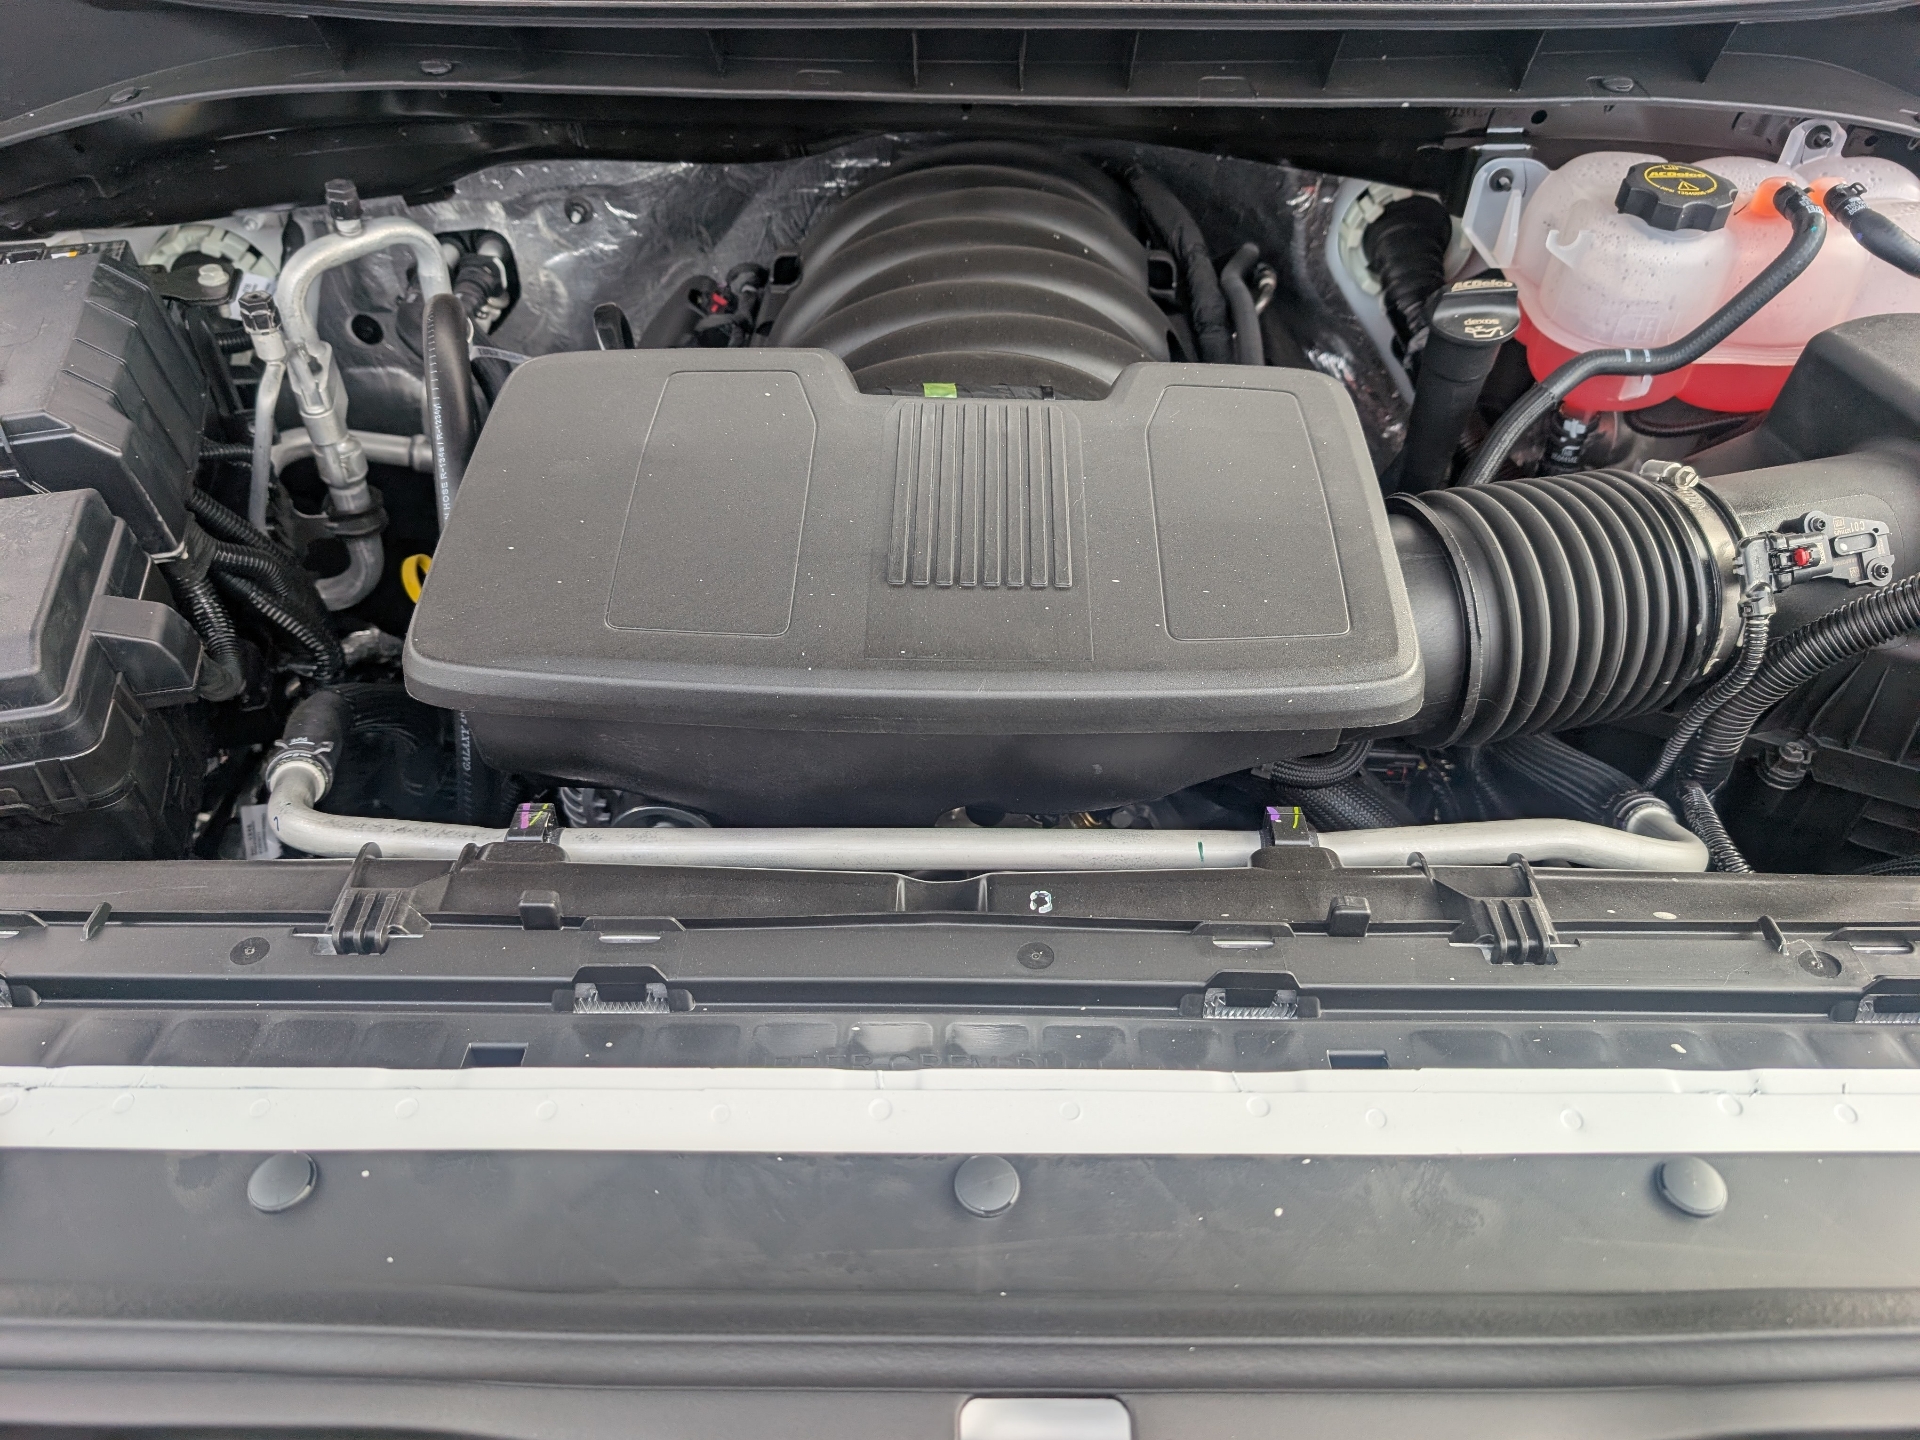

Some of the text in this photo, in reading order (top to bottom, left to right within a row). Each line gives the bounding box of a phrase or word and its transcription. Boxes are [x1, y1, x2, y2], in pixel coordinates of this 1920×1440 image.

[1451, 279, 1513, 293] ACDelco
[441, 481, 451, 510] HOSE
[461, 724, 471, 771] GALAXY
